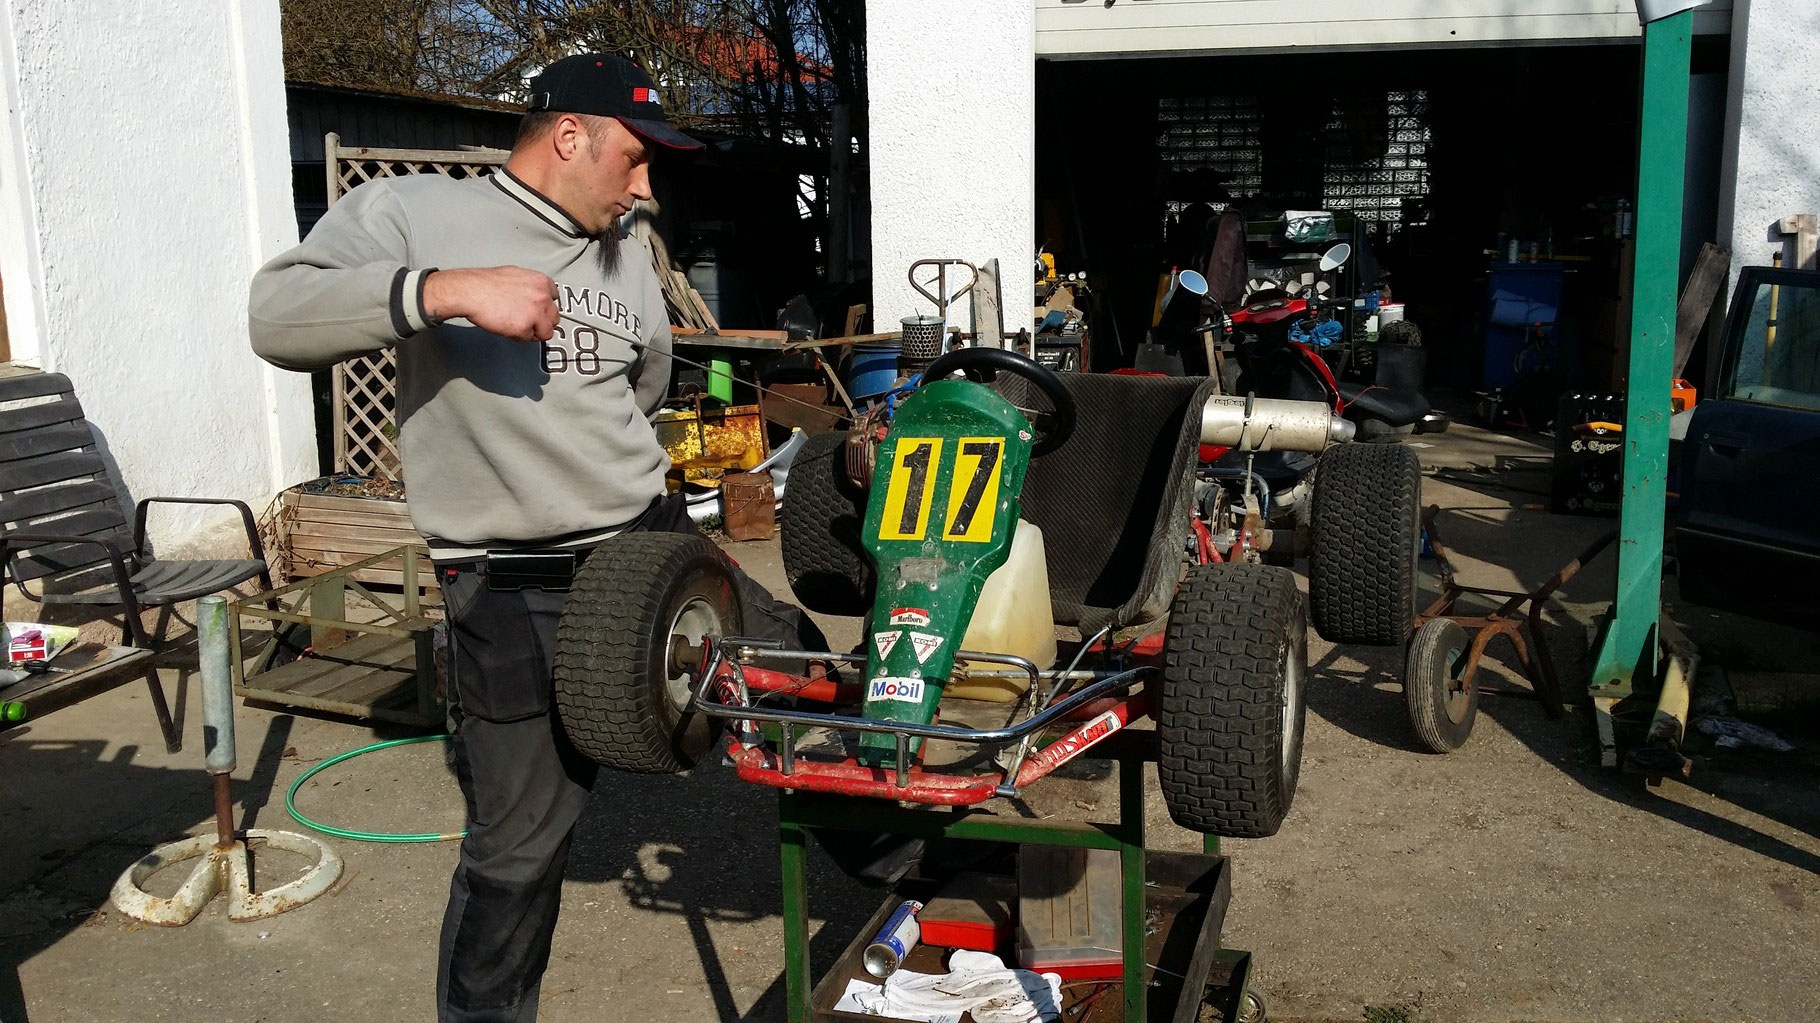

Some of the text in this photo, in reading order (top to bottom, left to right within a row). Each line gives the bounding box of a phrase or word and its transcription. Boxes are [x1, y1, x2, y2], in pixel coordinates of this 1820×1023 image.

[541, 326, 601, 376] 68
[898, 442, 1001, 536] 17
[897, 614, 923, 624] Marlboro
[871, 681, 920, 699] Mobil
